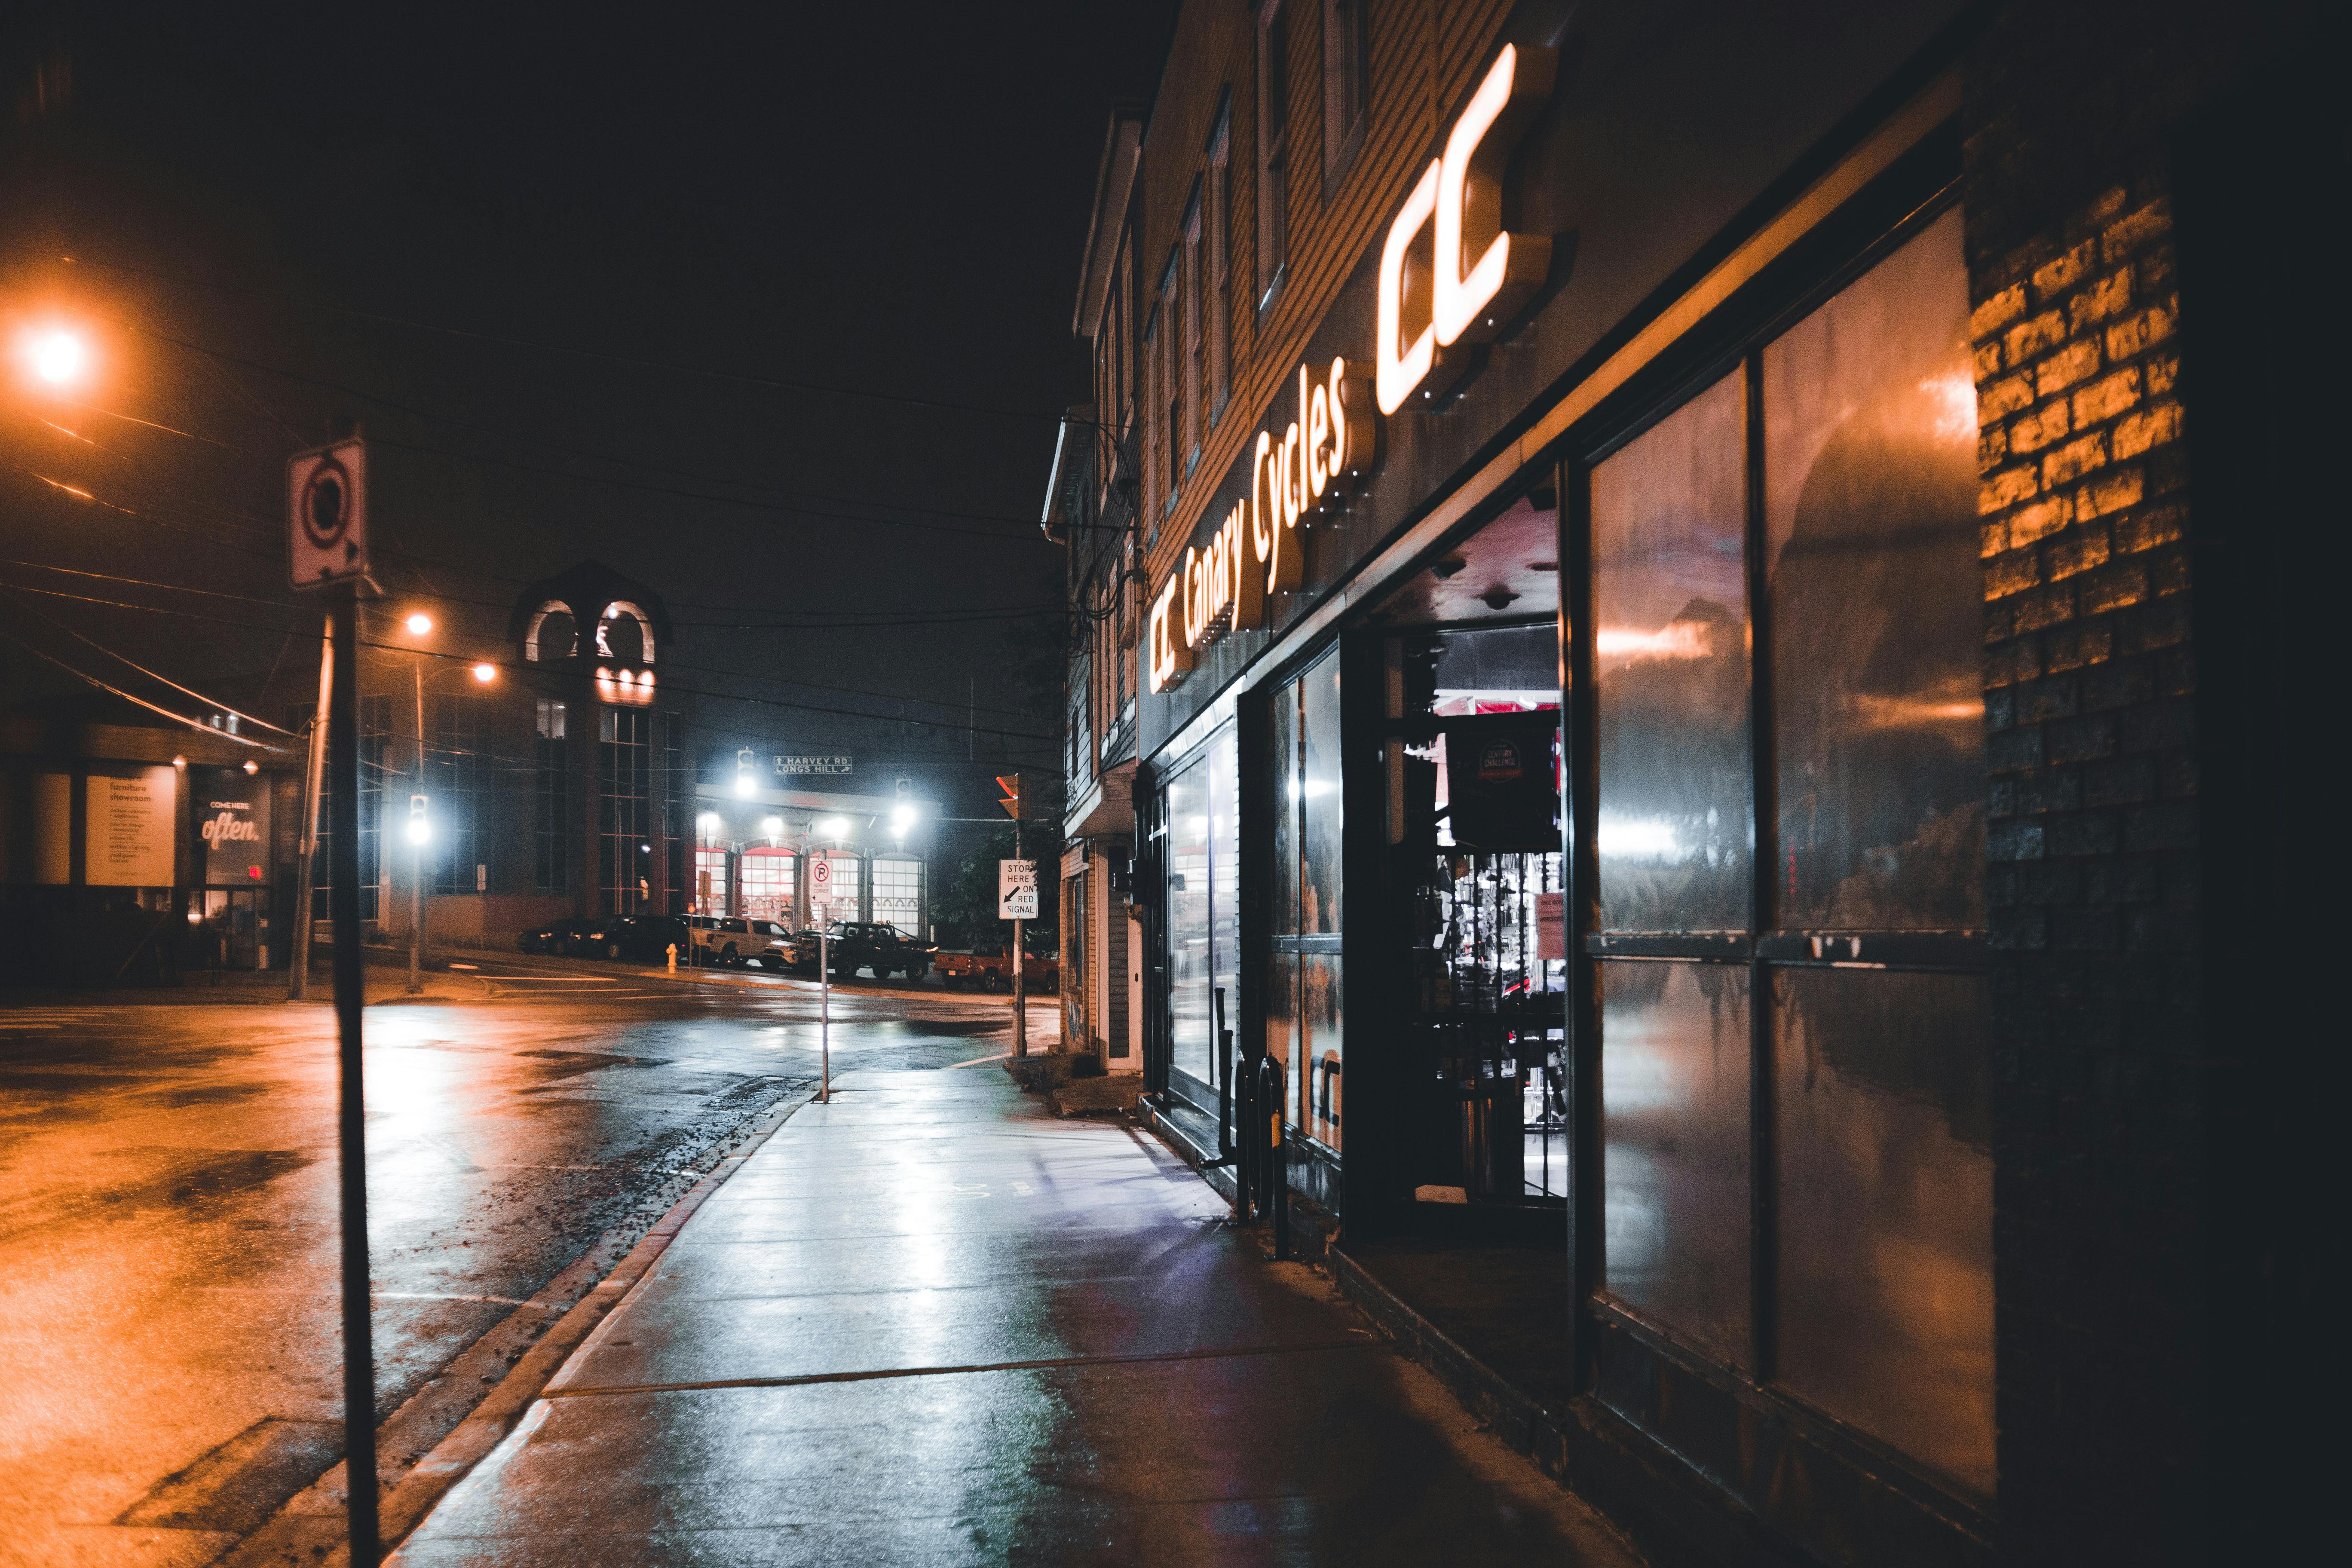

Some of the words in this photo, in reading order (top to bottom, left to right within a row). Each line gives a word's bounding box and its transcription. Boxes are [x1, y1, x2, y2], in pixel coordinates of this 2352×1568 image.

[1184, 499, 1244, 648] Canary
[1253, 356, 1345, 594] Cycles
[110, 782, 146, 791] furniture
[110, 792, 151, 801] showroom
[202, 812, 259, 850] often.
